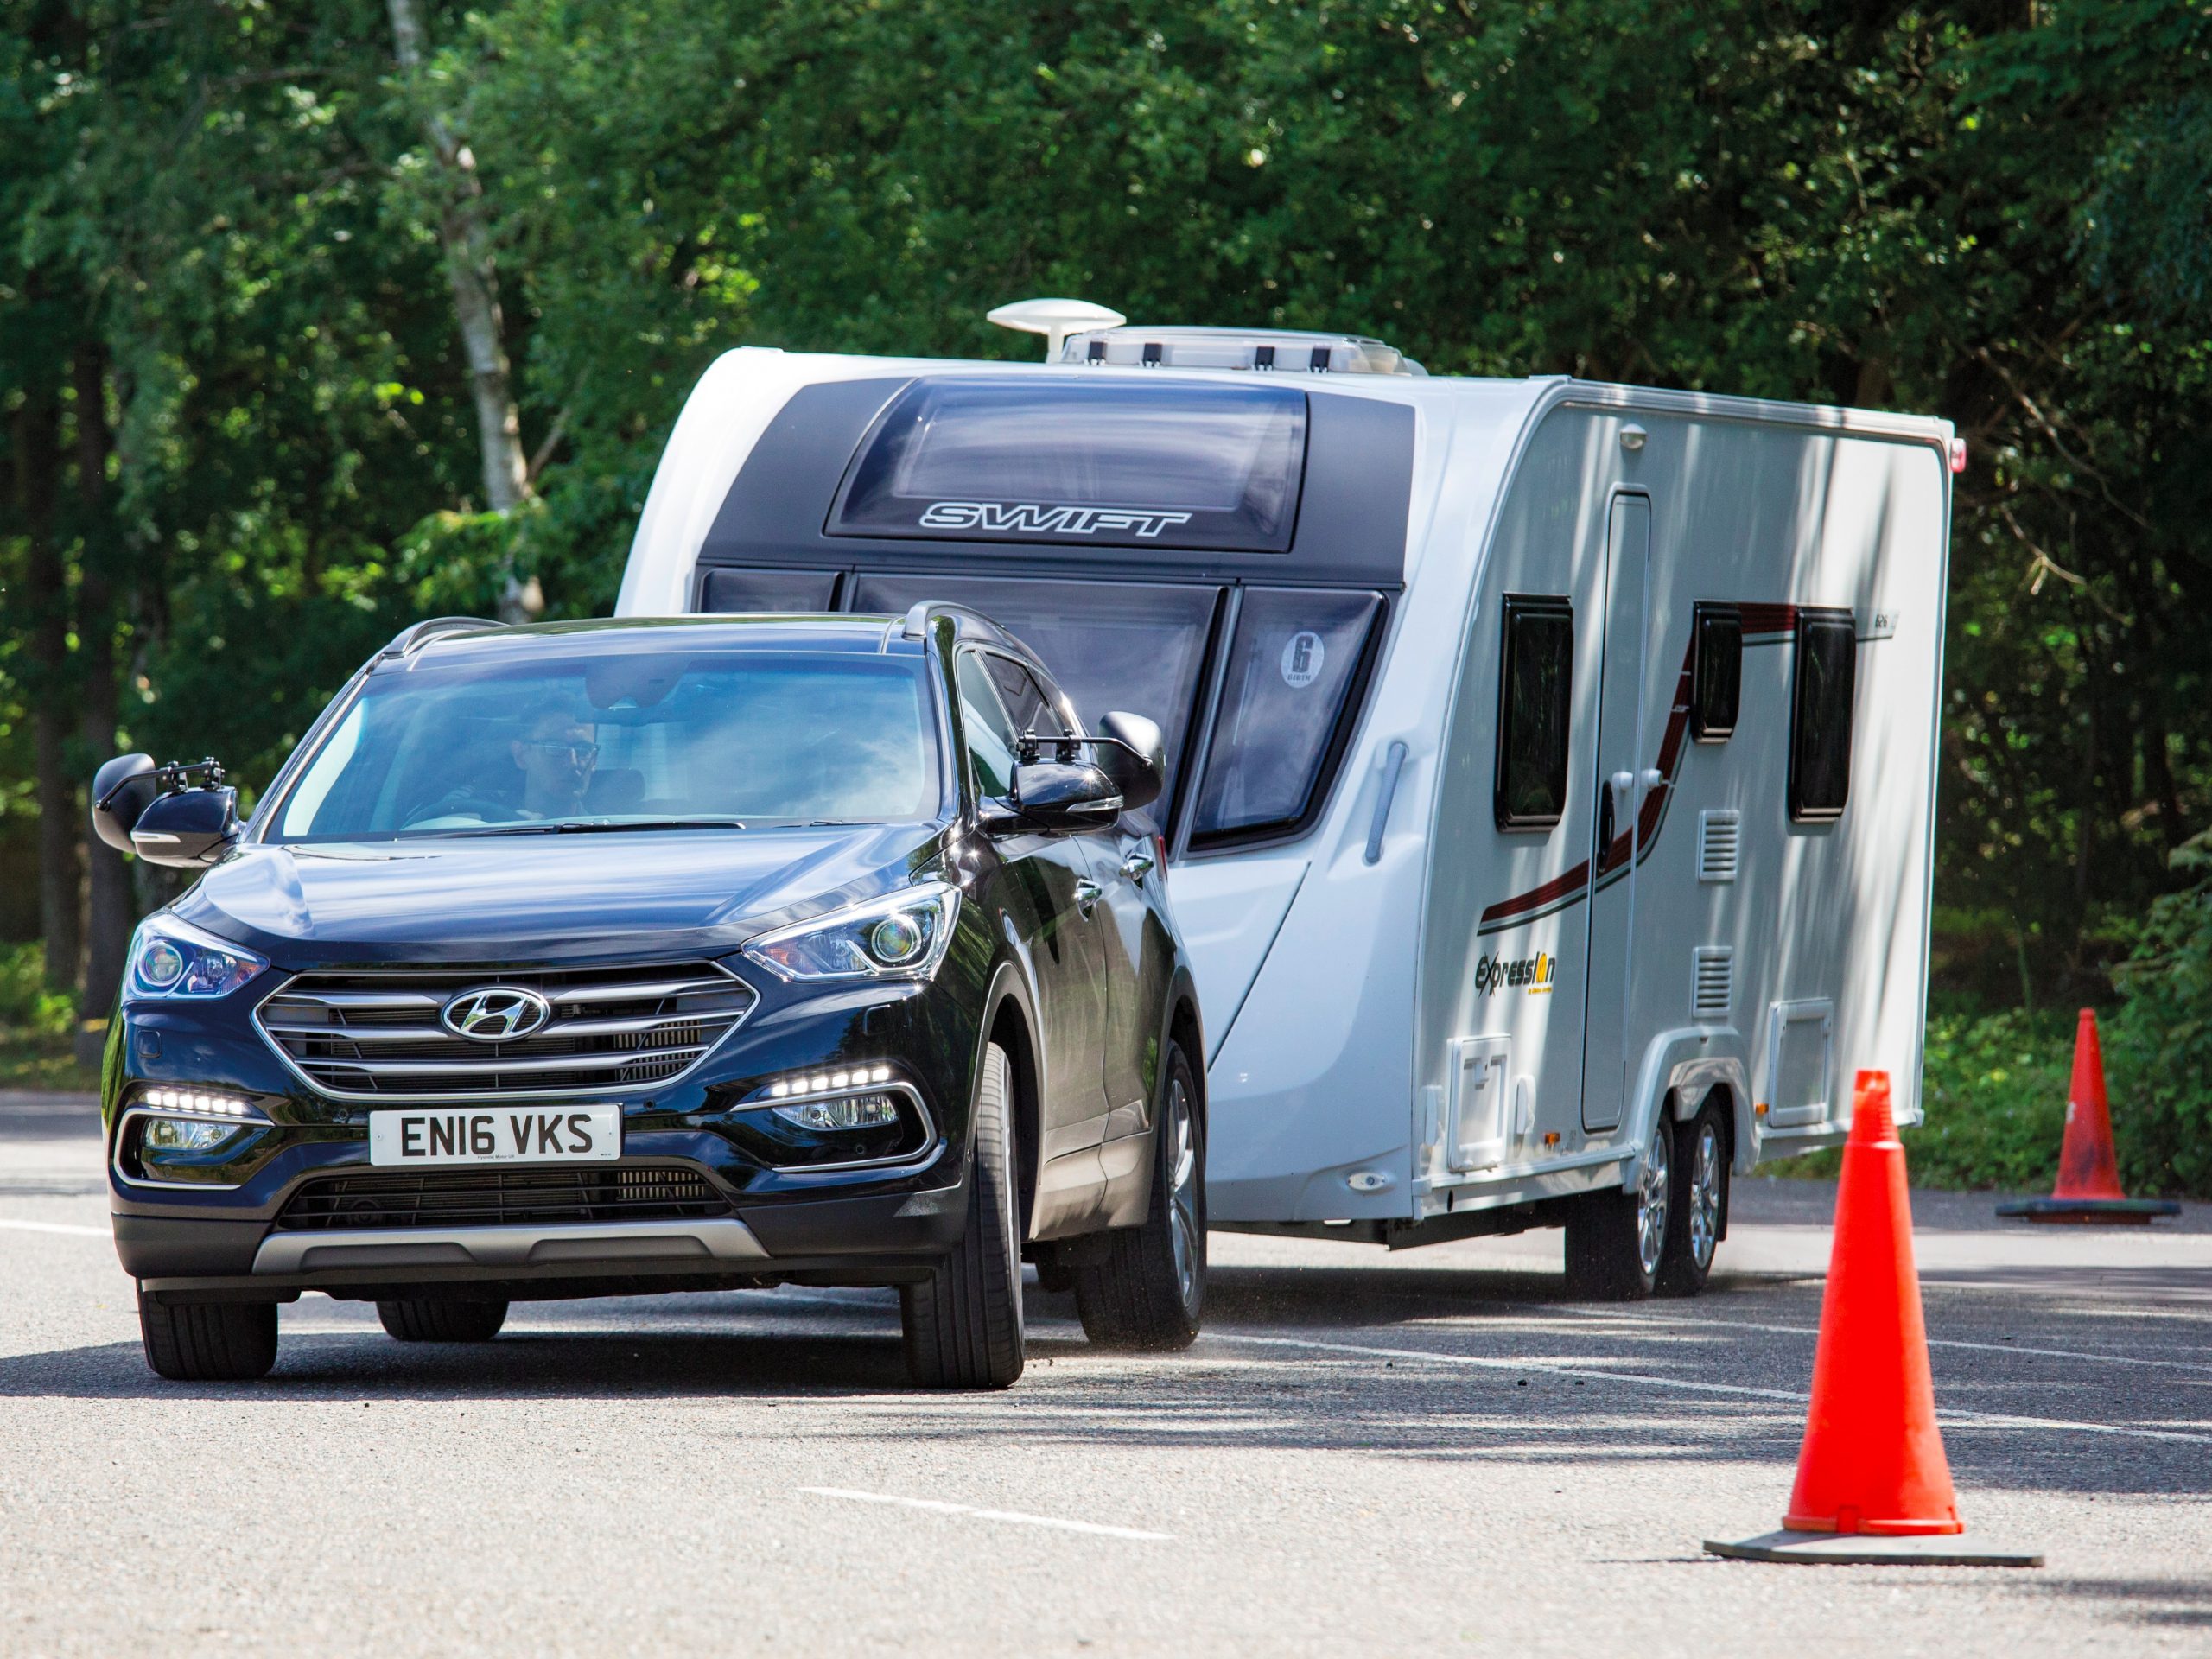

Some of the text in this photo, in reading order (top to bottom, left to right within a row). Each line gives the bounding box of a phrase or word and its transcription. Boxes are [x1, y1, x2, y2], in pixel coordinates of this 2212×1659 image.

[919, 502, 1192, 537] SWIFT
[1293, 636, 1313, 673] 6
[401, 1114, 593, 1156] EN16 VKS
